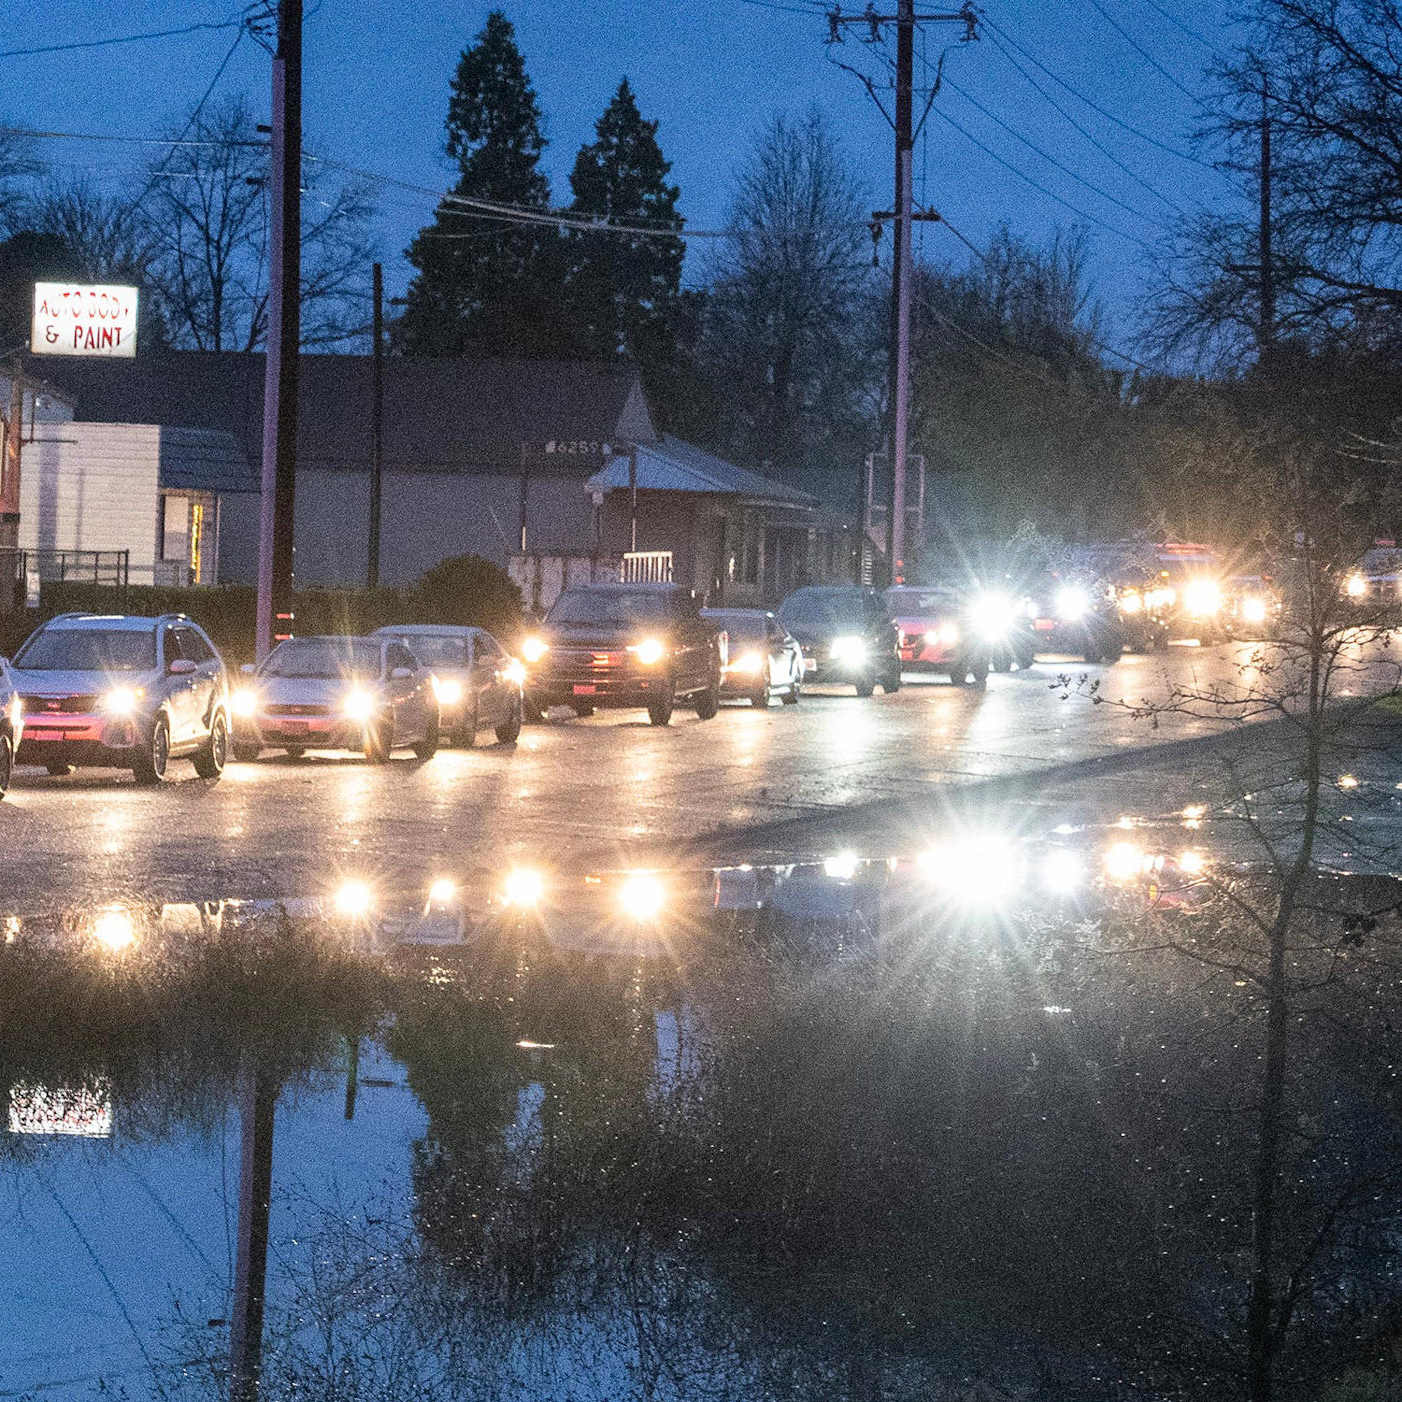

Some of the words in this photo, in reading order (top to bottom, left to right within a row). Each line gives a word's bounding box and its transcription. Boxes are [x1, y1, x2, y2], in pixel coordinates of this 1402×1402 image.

[39, 291, 81, 318] AUTO
[45, 325, 60, 345] &
[73, 325, 122, 350] PAINT
